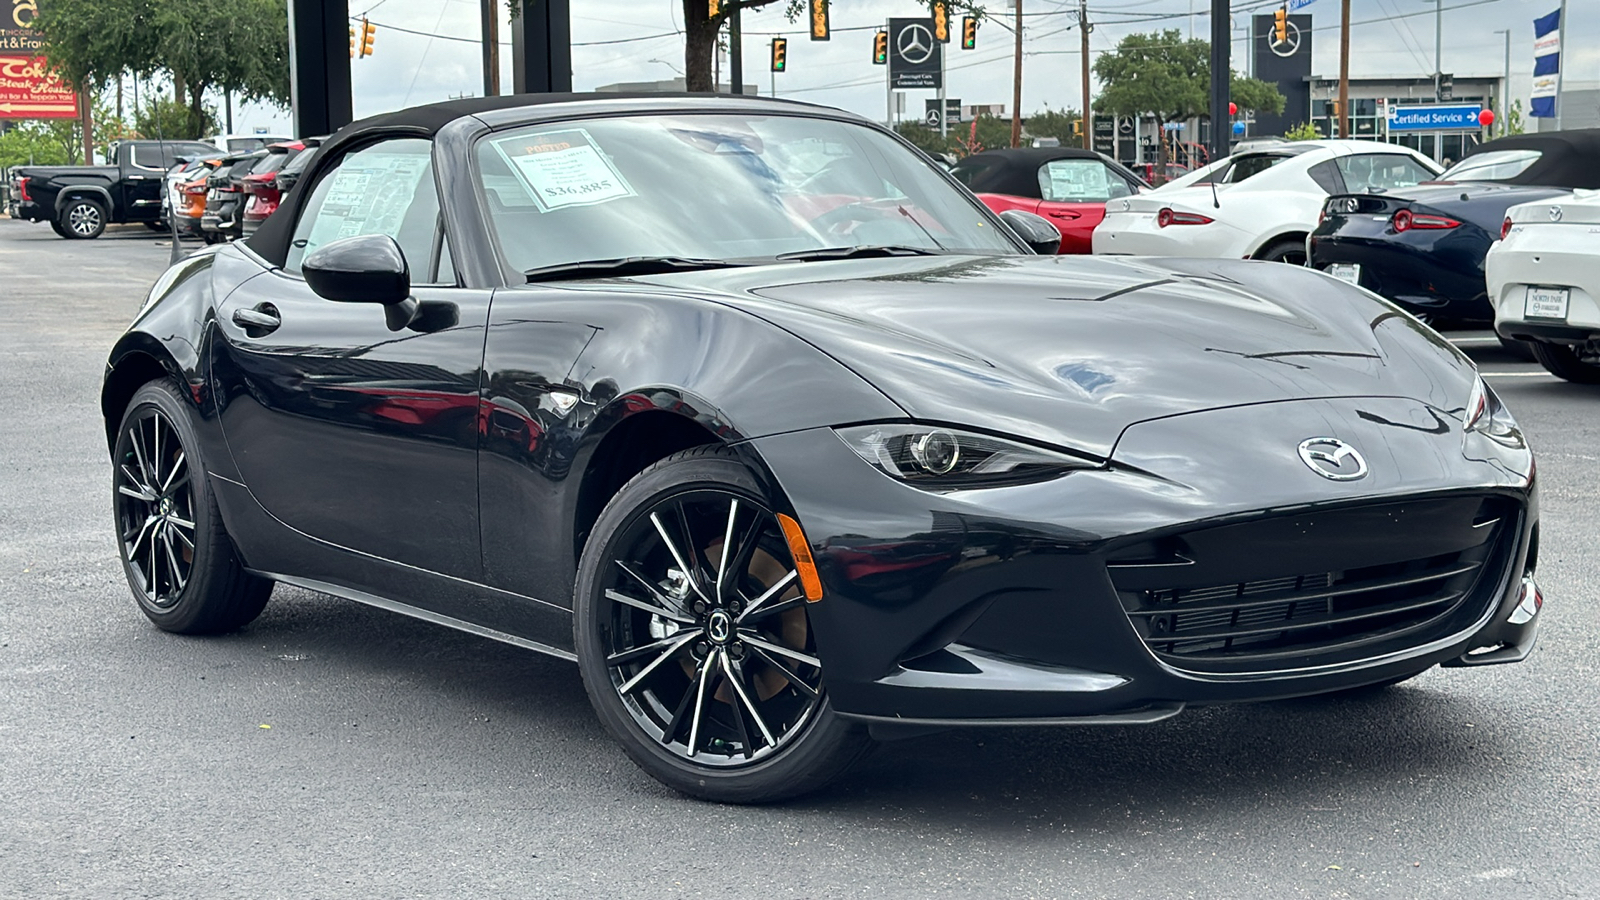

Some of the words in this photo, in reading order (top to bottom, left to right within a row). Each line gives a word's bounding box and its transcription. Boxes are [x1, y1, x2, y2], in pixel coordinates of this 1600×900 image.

[1393, 114, 1430, 124] Certified
[1432, 112, 1463, 123] Service
[525, 142, 570, 155] POSTED
[545, 180, 612, 197] $36,885
